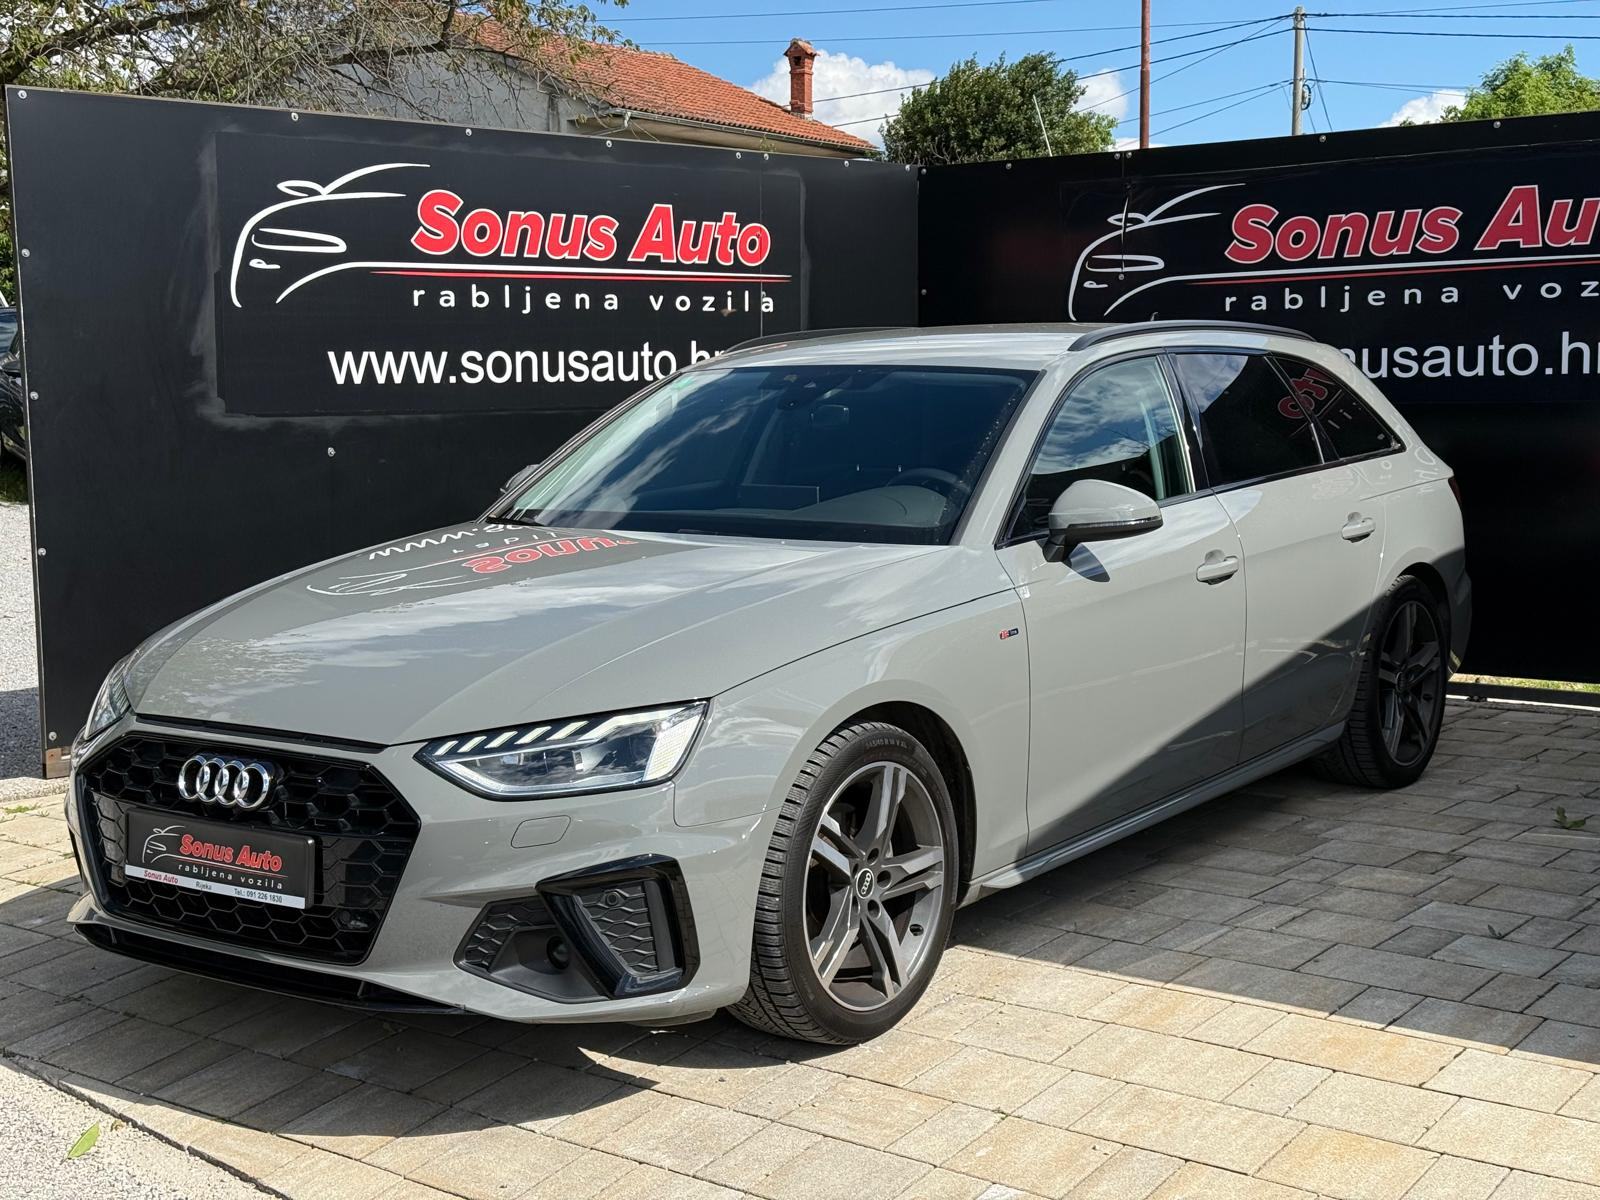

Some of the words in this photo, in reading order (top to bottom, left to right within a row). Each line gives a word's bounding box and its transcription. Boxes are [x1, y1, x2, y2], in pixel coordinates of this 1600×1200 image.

[411, 188, 620, 262] Sonus
[627, 203, 771, 266] Auto
[1224, 204, 1463, 265] Sonus
[412, 284, 619, 314] rabljena
[649, 289, 775, 314] vozila
[1225, 285, 1460, 313] rabljena
[180, 834, 234, 863] Sonus
[235, 845, 282, 872] Auto
[143, 870, 162, 881] Sonus
[163, 874, 179, 884] Auto
[246, 890, 256, 899] 091
[178, 864, 233, 880] rabljena
[240, 876, 283, 890] vozila
